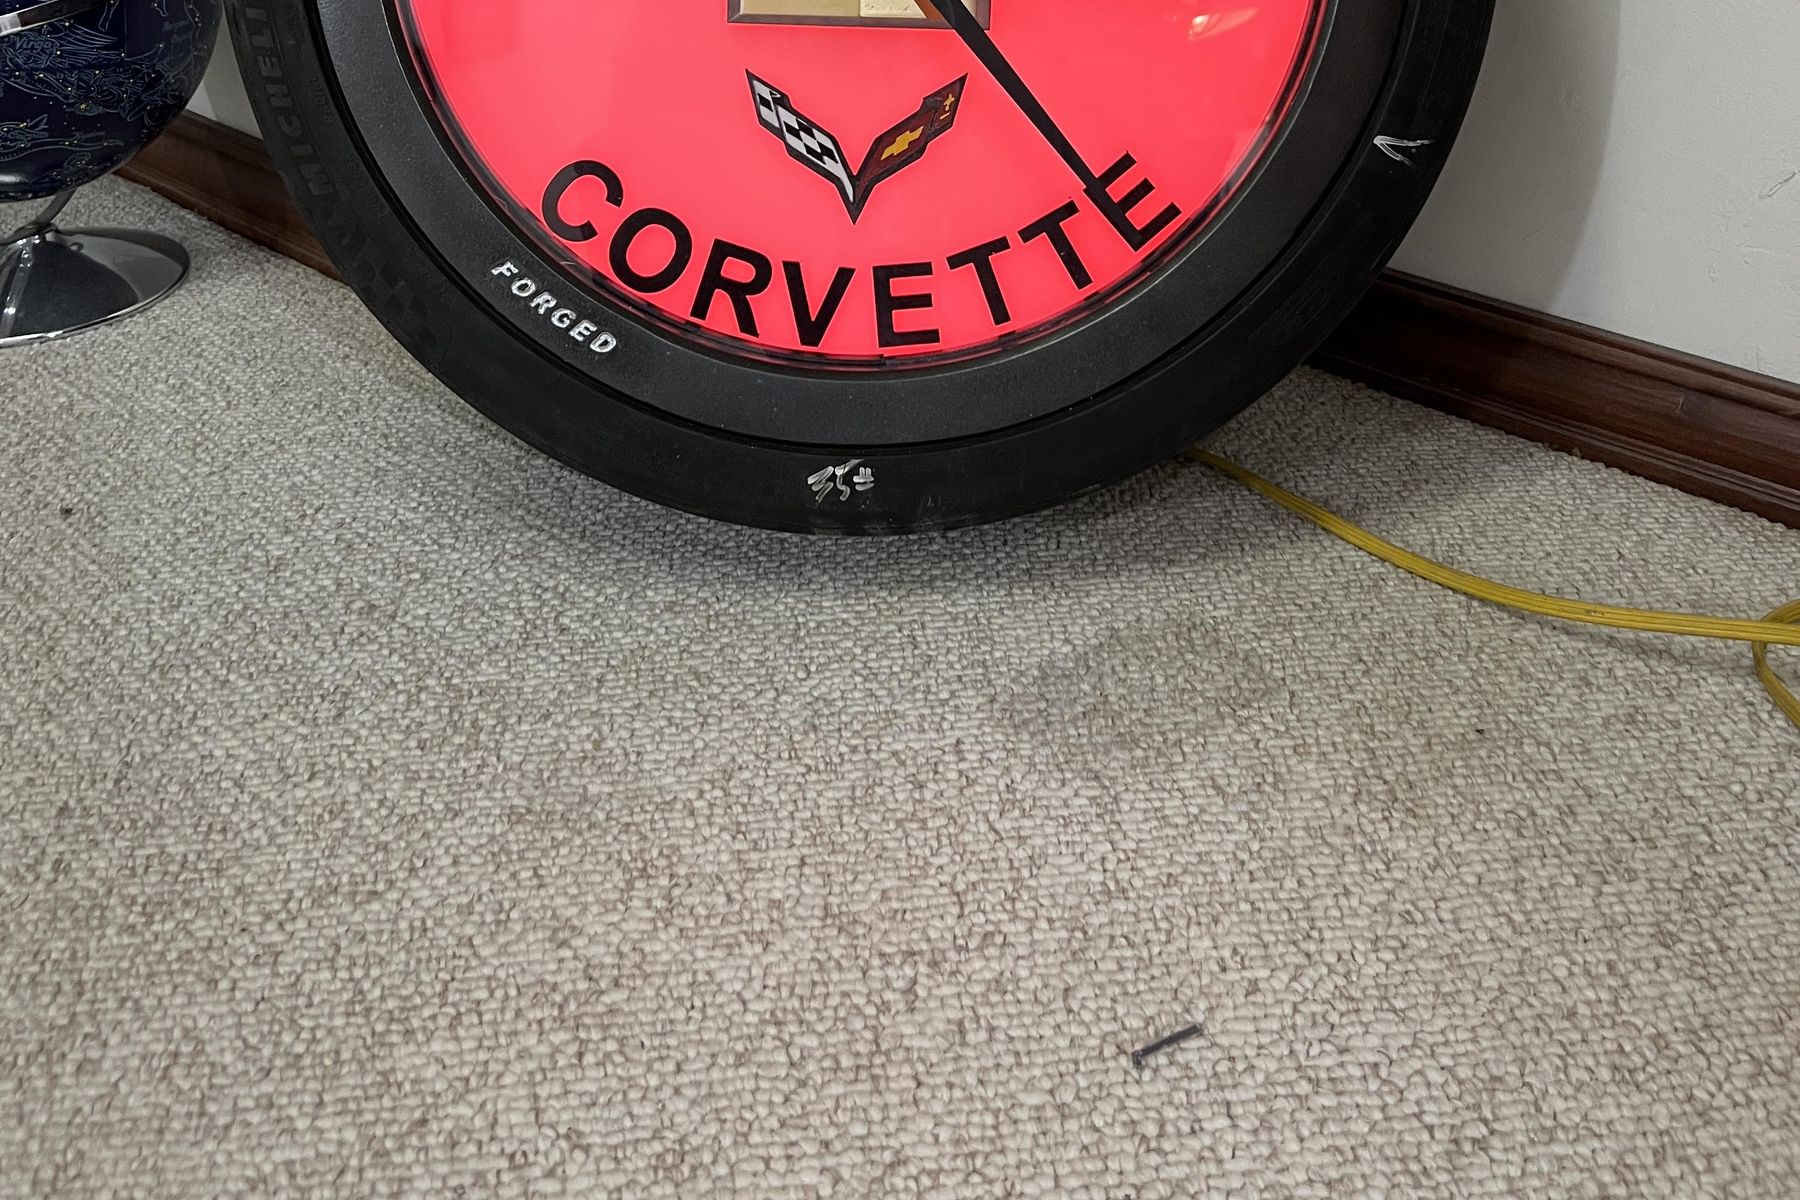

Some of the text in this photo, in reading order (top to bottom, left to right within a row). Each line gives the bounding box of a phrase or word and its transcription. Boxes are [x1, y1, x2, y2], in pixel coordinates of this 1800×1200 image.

[16, 36, 52, 53] Virgo
[541, 152, 1182, 349] CORVETTE
[491, 261, 617, 353] FORGED
